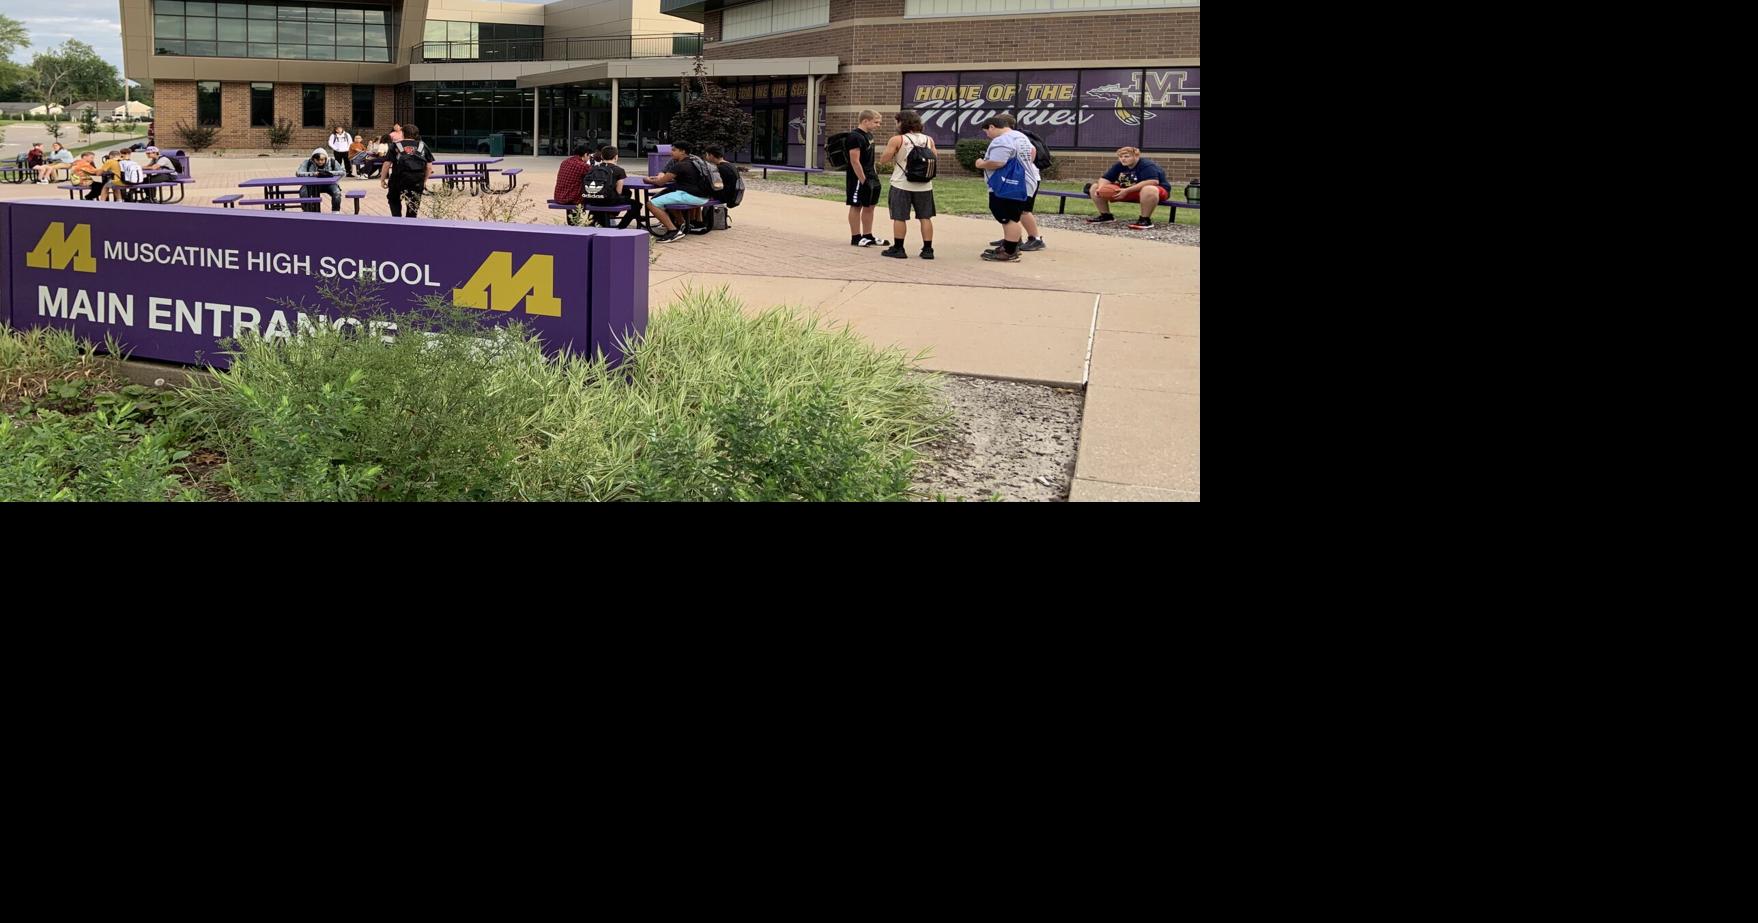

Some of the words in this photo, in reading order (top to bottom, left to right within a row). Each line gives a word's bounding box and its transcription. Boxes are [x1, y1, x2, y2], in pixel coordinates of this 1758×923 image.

[913, 85, 984, 102] HOME
[986, 83, 1021, 102] OF
[1026, 84, 1077, 102] THE
[26, 221, 97, 273] M
[103, 240, 240, 270] MUSCATINE
[247, 251, 311, 276] HIGH
[320, 256, 441, 287] SCHOOL
[38, 285, 134, 327] MAIN
[453, 251, 562, 317] M
